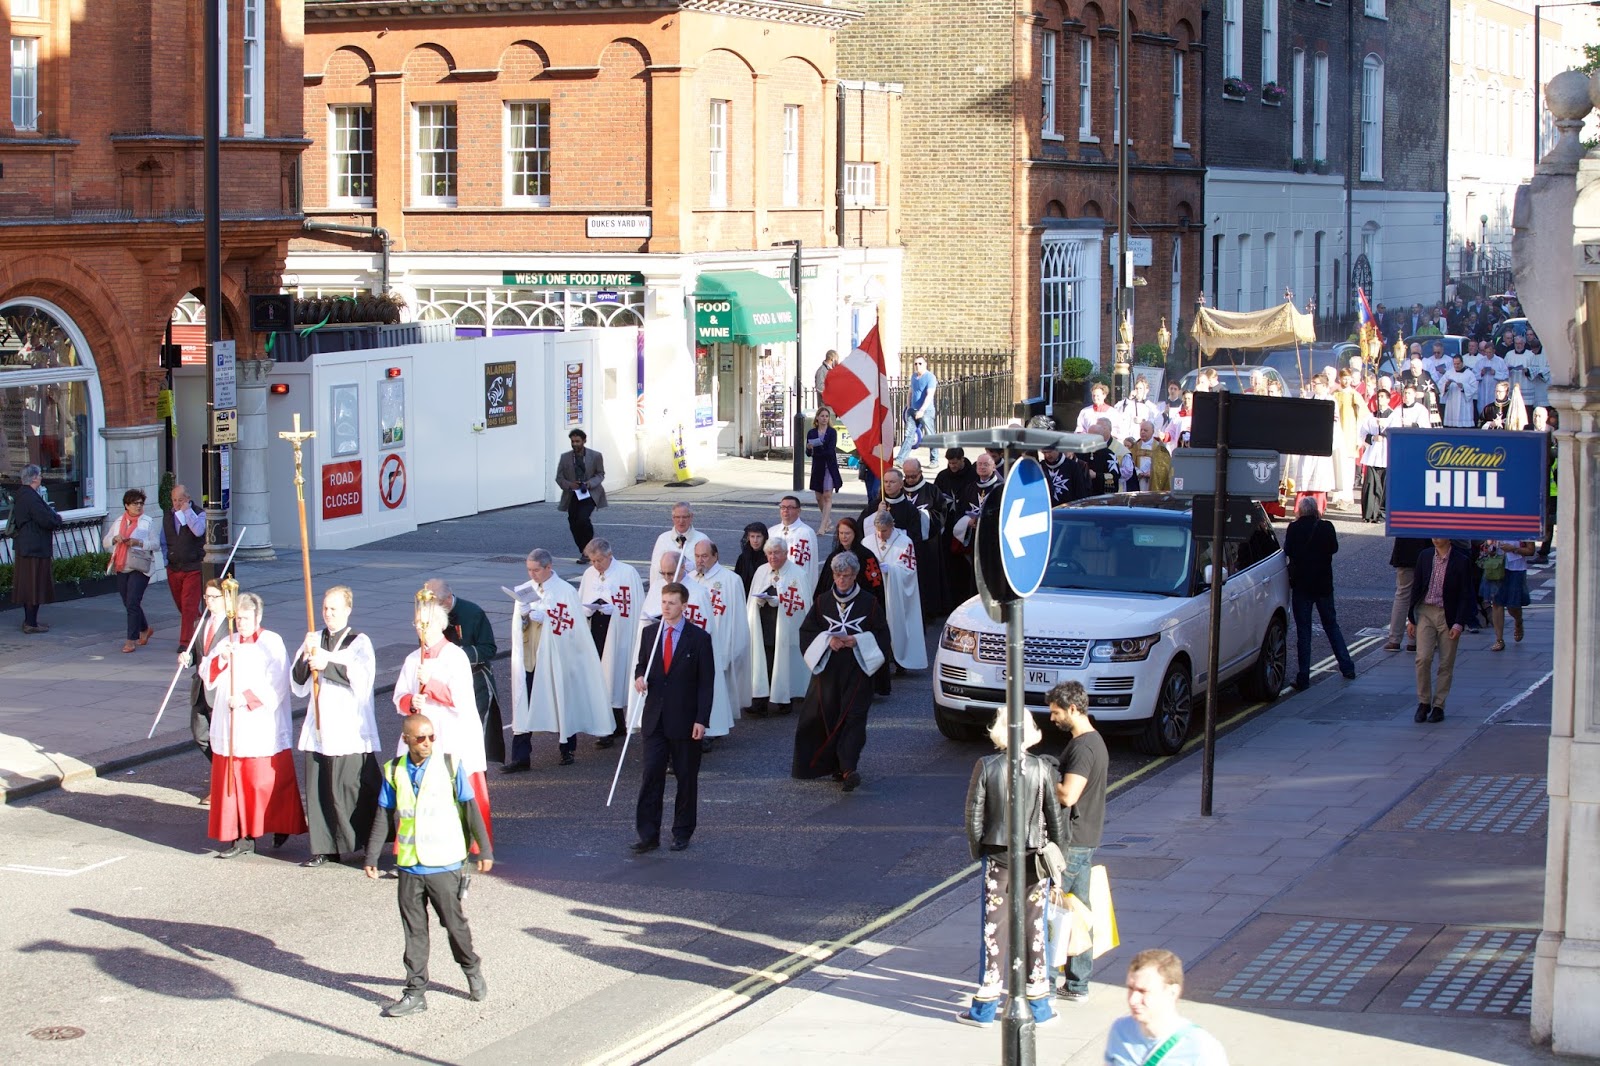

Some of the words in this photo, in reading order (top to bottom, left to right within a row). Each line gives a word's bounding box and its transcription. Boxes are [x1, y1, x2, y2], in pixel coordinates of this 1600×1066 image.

[618, 219, 636, 228] YARD
[515, 272, 543, 285] WEST
[545, 272, 567, 285] ONE
[570, 273, 599, 285] FOOD
[601, 273, 632, 285] FAYRE
[696, 302, 731, 312] FOOD
[709, 315, 718, 324] &
[752, 313, 771, 325] FOOD
[777, 311, 793, 323] WINE
[699, 327, 730, 337] WINE
[486, 363, 515, 375] ALARMED
[1426, 441, 1506, 471] William
[330, 471, 354, 486] ROAD
[1425, 470, 1505, 508] HILL
[325, 492, 360, 509] CLOSED
[1029, 671, 1050, 683] VRL
